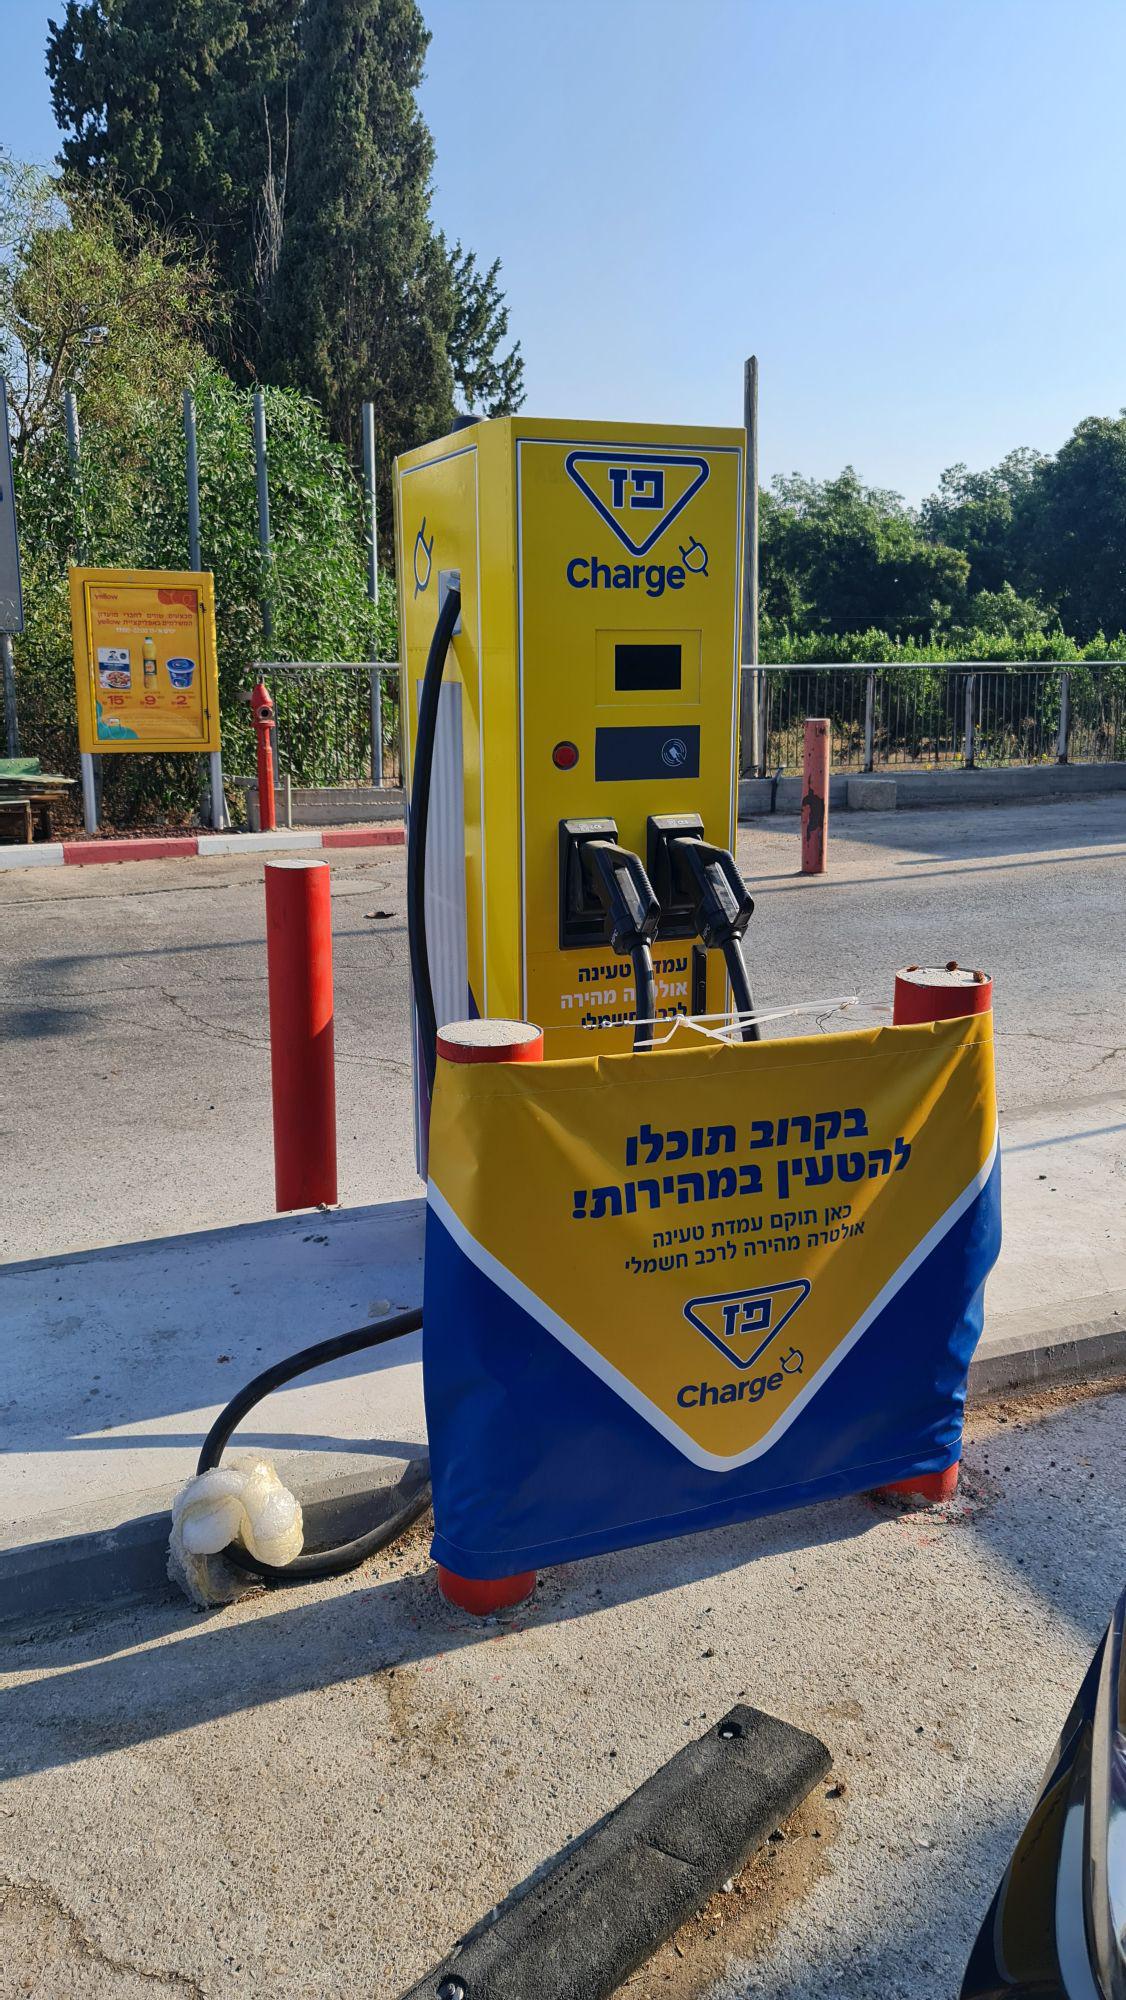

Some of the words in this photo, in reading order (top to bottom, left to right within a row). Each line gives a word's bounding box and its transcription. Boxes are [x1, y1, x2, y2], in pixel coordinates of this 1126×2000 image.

[608, 467, 664, 510] פז
[566, 556, 686, 598] Charge
[107, 695, 124, 706] 15
[144, 695, 157, 706] 9
[176, 695, 188, 705] 2
[578, 963, 632, 982] טעינה
[652, 957, 688, 974] עמד
[560, 987, 617, 1009] מהירה
[623, 980, 688, 1002] אולה
[654, 1002, 688, 1020] לרכ
[750, 1107, 869, 1150] בקרוב
[626, 1123, 736, 1167] תוכלו
[777, 1136, 912, 1200] להטעין
[572, 1164, 763, 1219] במהירות!
[711, 1215, 763, 1239] עמדת
[769, 1209, 818, 1232] תוקם
[824, 1204, 852, 1227] כאן
[652, 1225, 705, 1248] טעינה
[743, 1235, 801, 1257] מהירה
[807, 1221, 865, 1248] אולטרה
[624, 1252, 689, 1275] חשמלי
[695, 1241, 737, 1266] לרכב
[722, 1298, 772, 1337] פז
[676, 1371, 784, 1409] Charge
